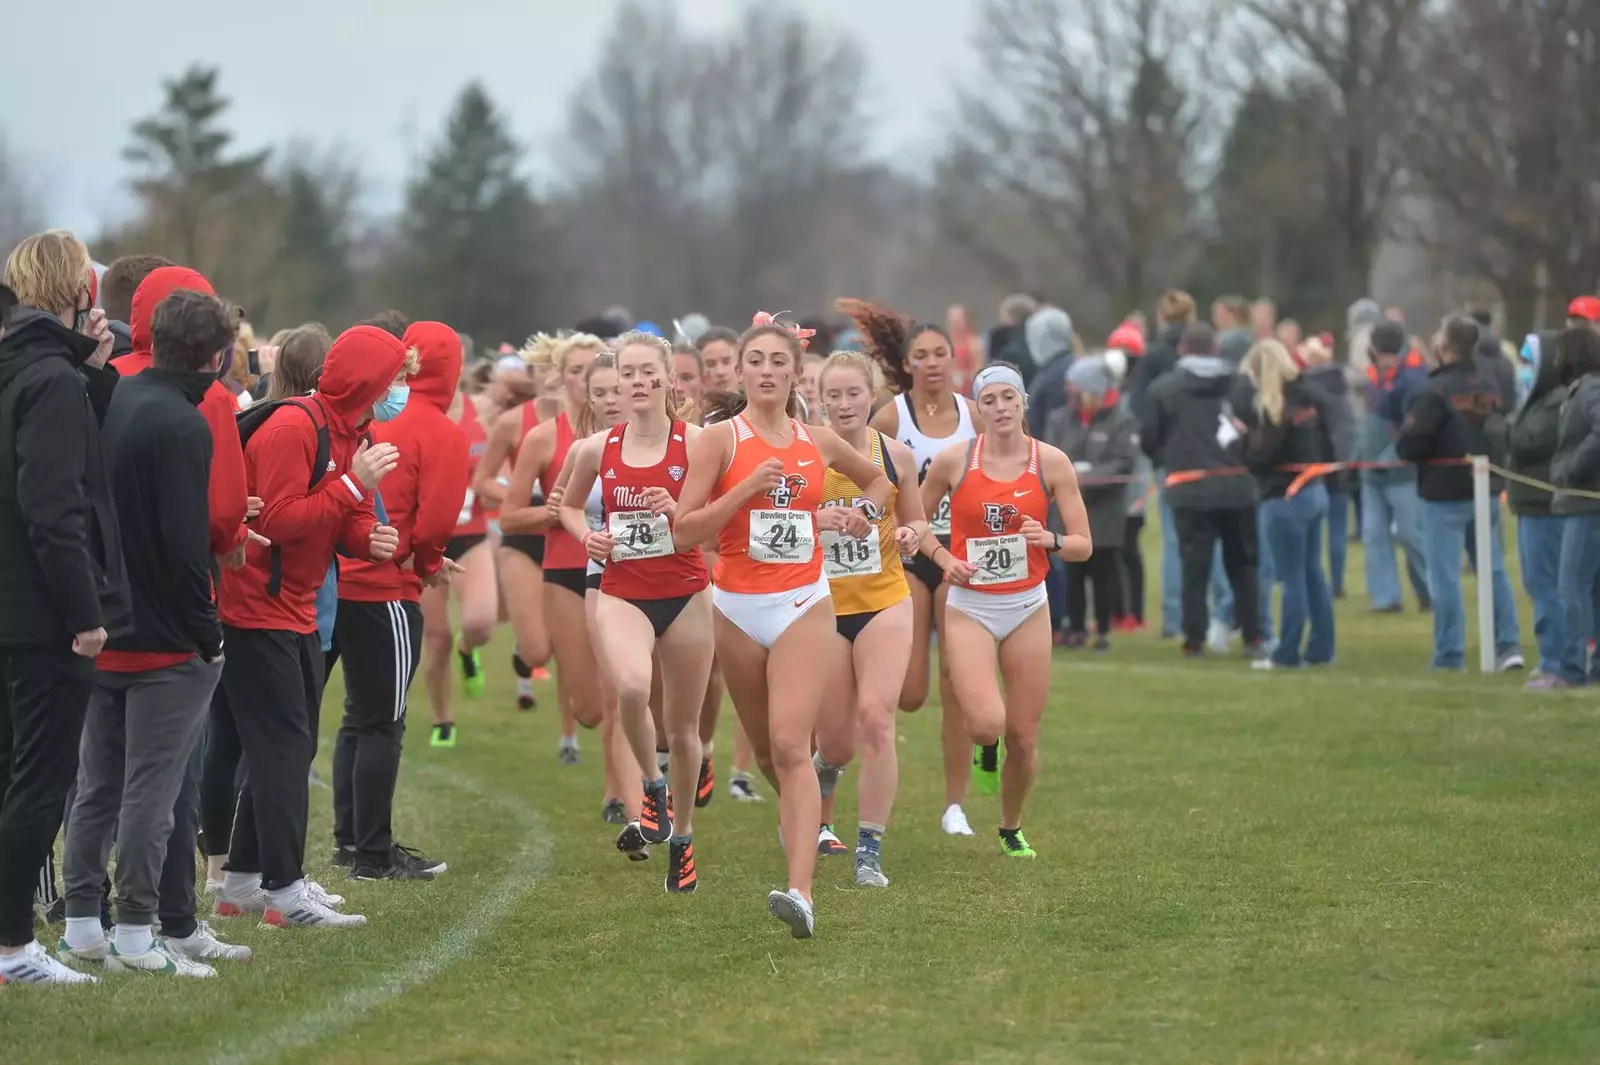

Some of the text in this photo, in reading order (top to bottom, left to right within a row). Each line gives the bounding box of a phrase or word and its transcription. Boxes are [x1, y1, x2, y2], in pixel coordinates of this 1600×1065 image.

[760, 511, 805, 520] Bowling Green
[626, 523, 653, 546] 78
[770, 524, 798, 548] 24
[831, 540, 869, 563] 115
[985, 549, 1011, 570] 20
